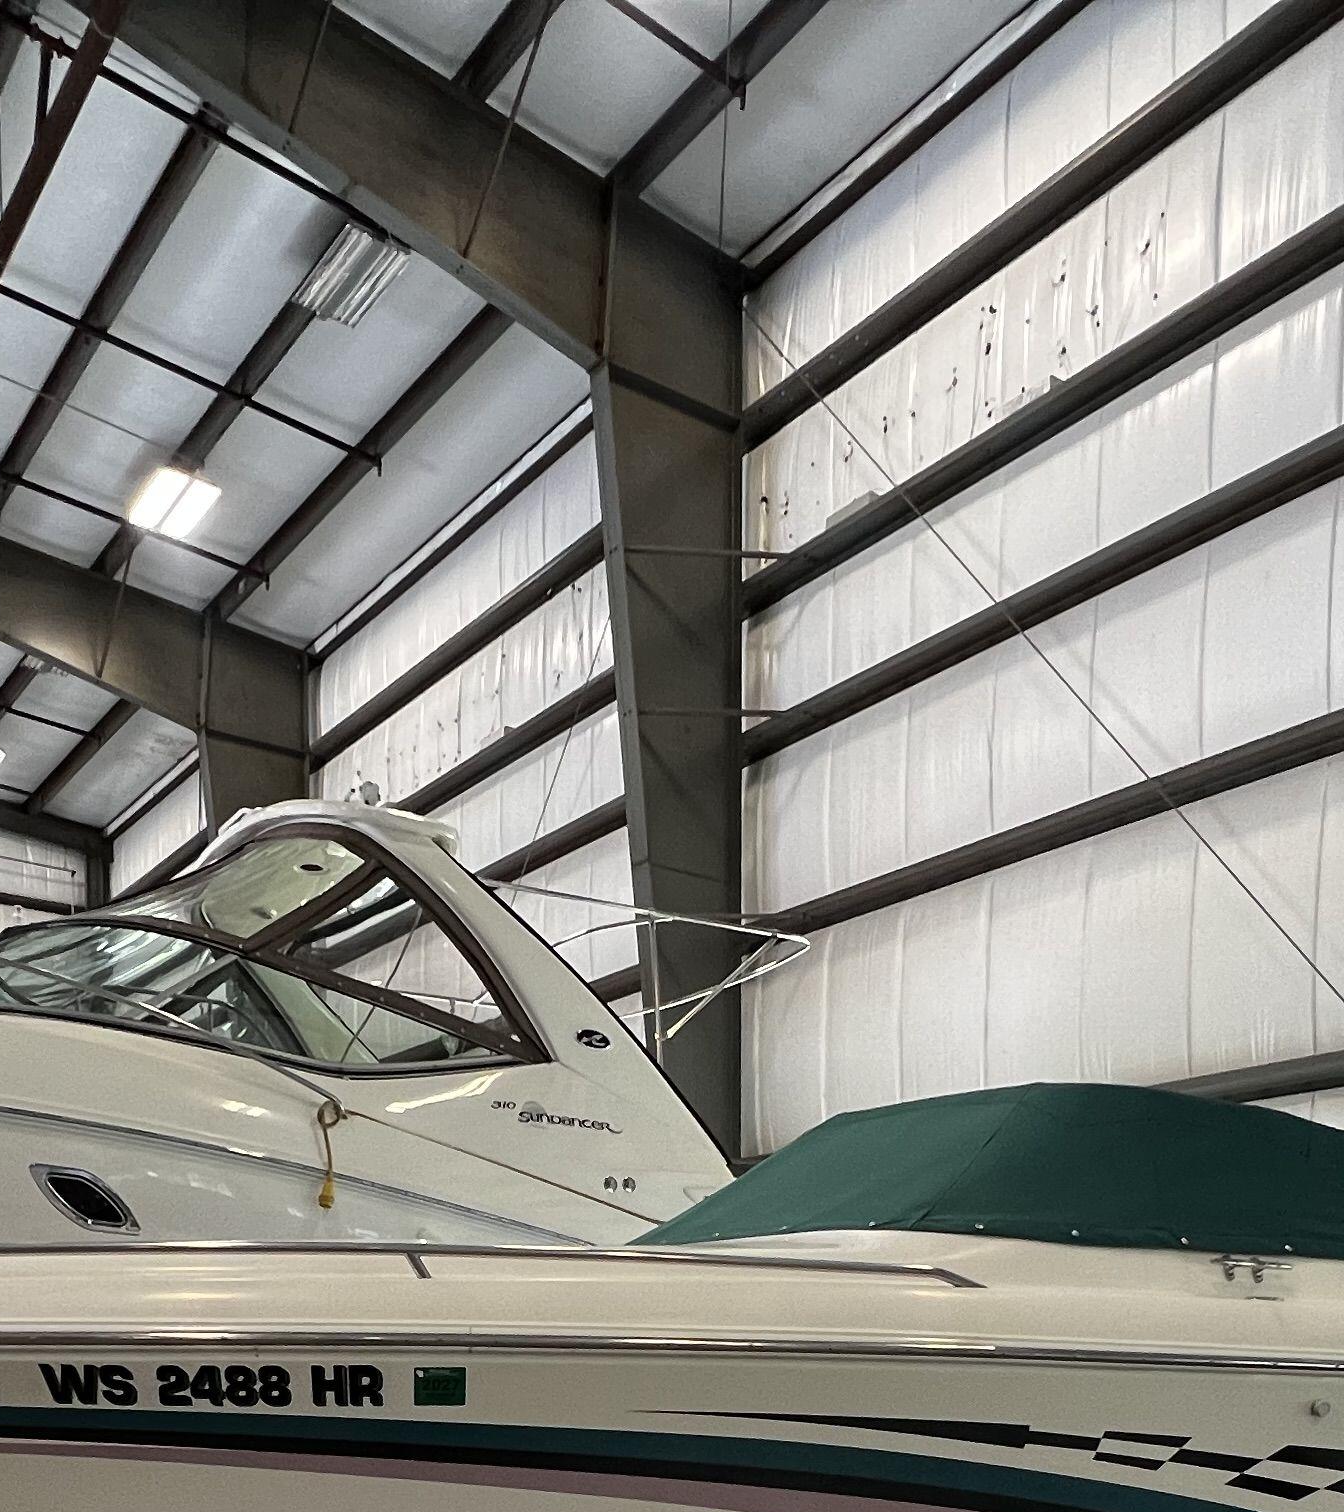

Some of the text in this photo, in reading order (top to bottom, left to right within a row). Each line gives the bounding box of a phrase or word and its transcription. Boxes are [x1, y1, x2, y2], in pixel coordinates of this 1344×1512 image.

[38, 1363, 384, 1408] WS 2488 HR
